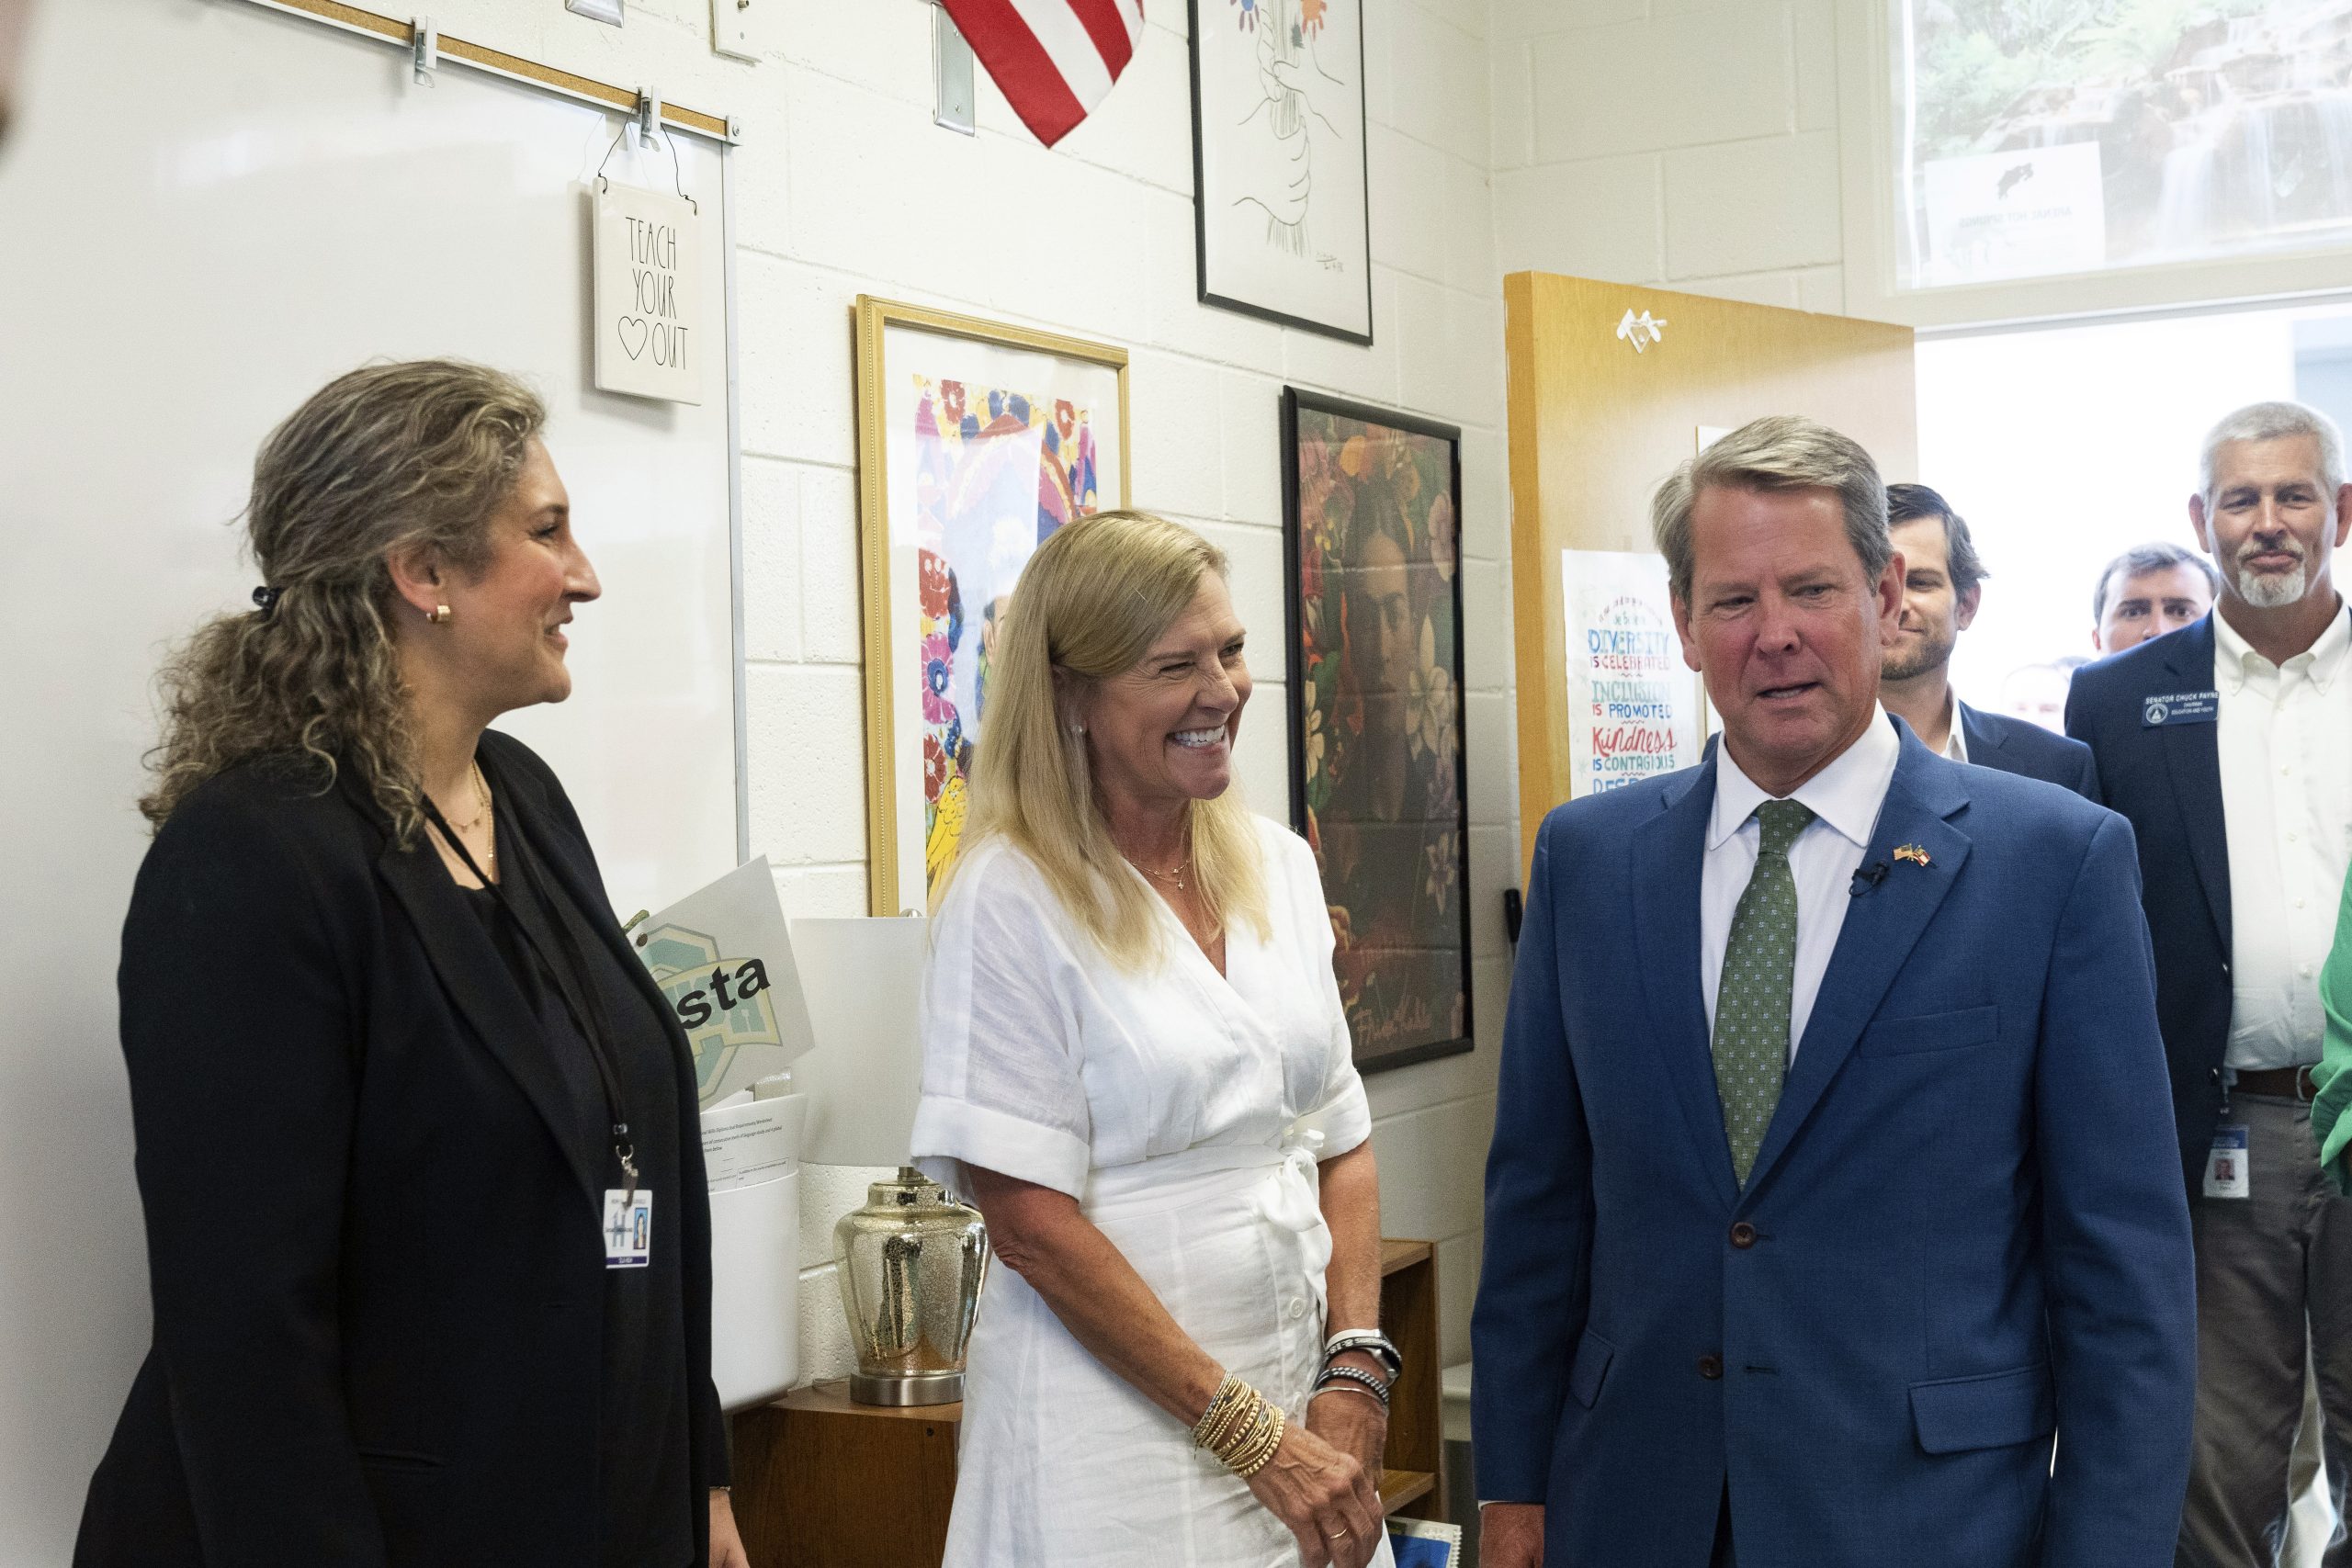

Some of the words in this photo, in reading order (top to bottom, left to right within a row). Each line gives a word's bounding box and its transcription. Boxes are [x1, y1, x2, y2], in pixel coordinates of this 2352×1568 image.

[626, 217, 676, 271] TEACH
[633, 268, 676, 320] YOUR
[652, 322, 688, 369] OUT
[1588, 629, 1669, 654] DIVERSITY
[1590, 656, 1600, 668] IS
[1601, 655, 1670, 671] CELEBRATED
[1591, 681, 1671, 703] INCLUSION
[2145, 694, 2175, 705] SENATOR
[2176, 693, 2198, 702] CHUCK
[2199, 691, 2220, 699] PAYNE
[1592, 705, 1602, 716] IS
[1609, 704, 1672, 719] PROMOTED
[1592, 726, 1678, 757] Kindness
[1593, 759, 1602, 771] IS
[1604, 754, 1675, 771] CONTAGIOUS
